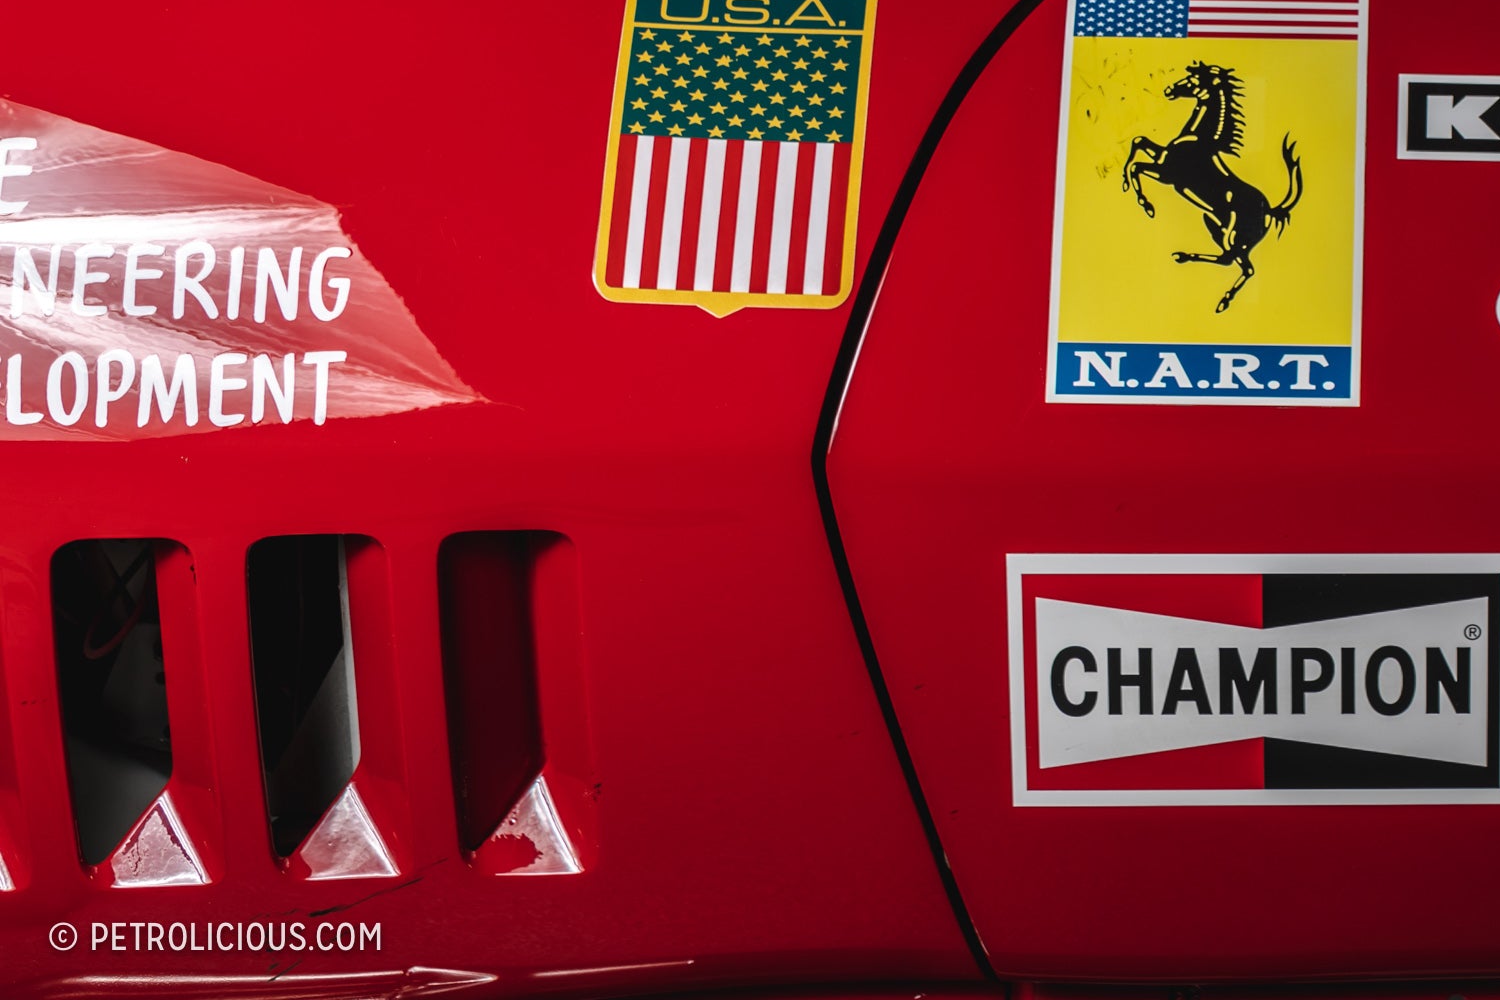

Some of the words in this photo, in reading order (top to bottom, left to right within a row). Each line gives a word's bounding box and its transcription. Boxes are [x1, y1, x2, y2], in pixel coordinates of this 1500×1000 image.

[9, 241, 352, 323] NEERING
[0, 348, 347, 427] LOPMENT
[1073, 351, 1336, 390] N.A.R.T.
[1050, 645, 1472, 717] CHAMPION
